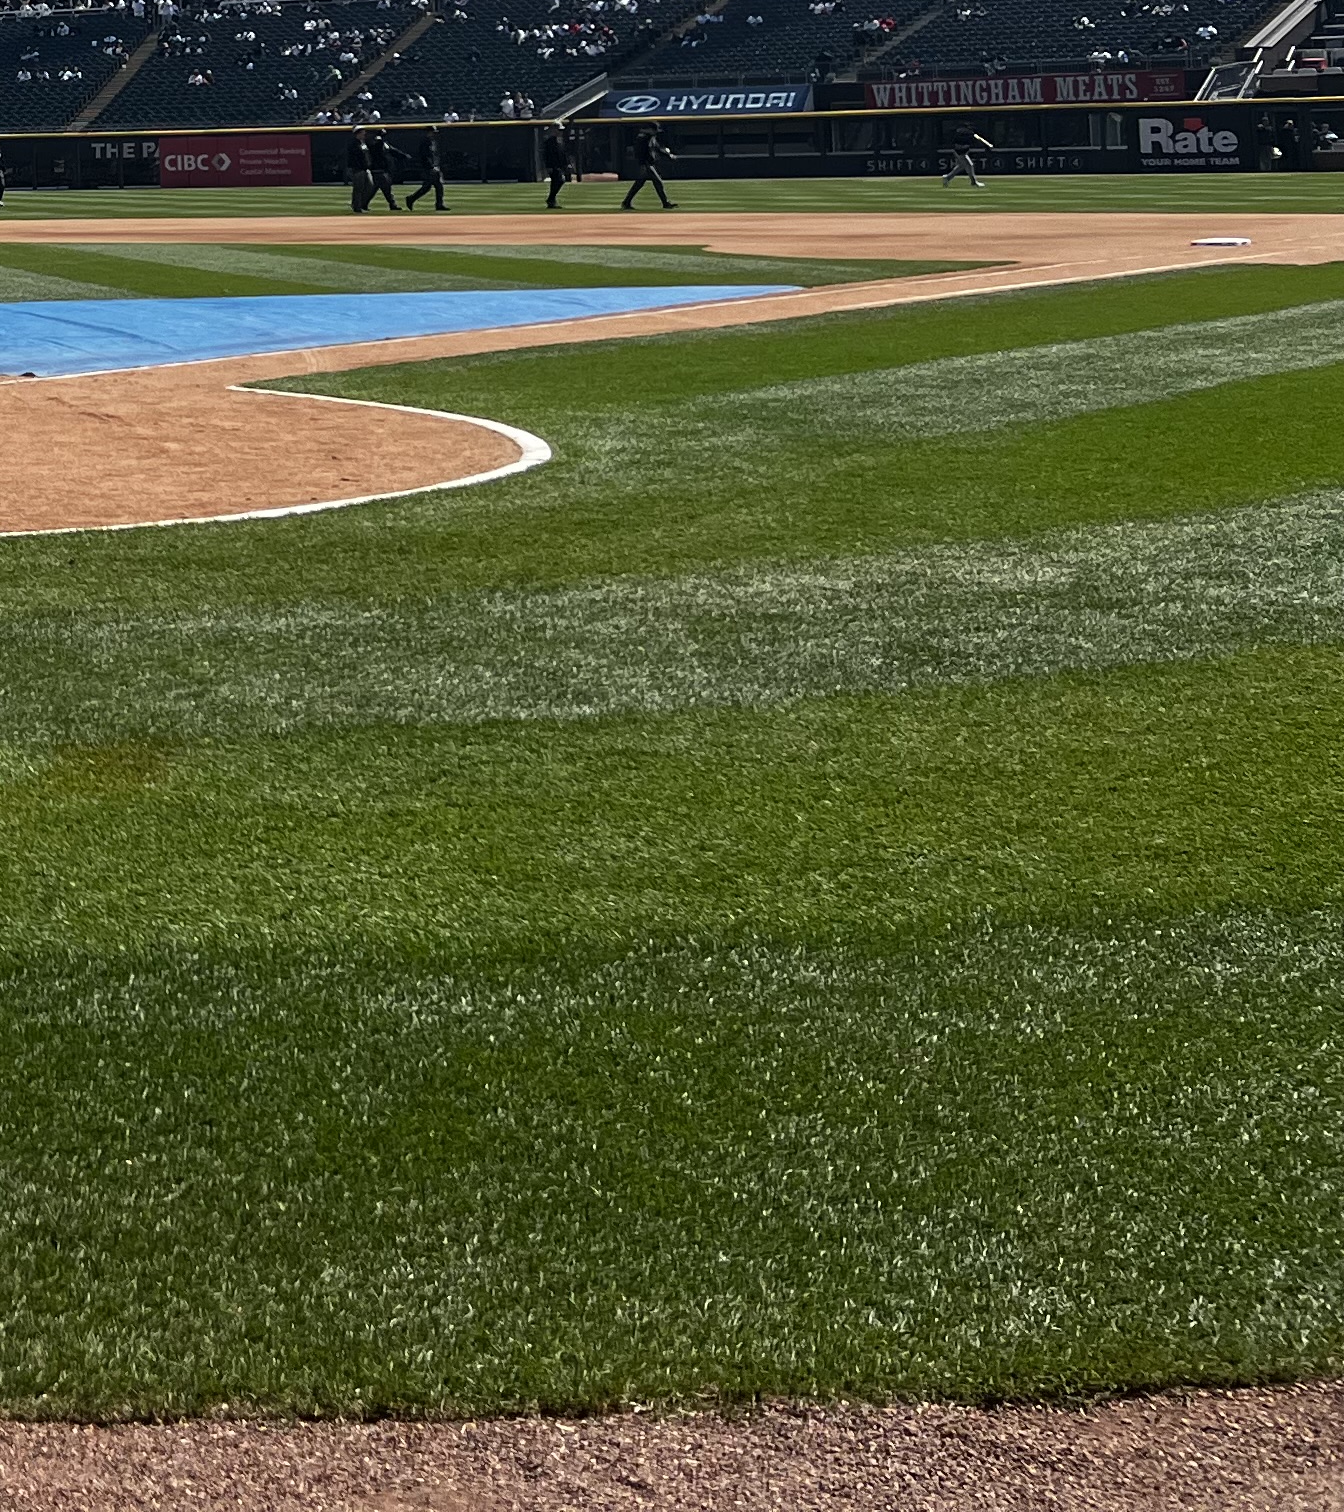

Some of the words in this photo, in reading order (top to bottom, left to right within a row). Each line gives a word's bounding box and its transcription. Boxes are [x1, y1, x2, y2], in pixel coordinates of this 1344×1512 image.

[871, 77, 1043, 108] WHITTINGHAM
[1055, 73, 1139, 102] MEATS
[666, 92, 796, 111] HYUNDAI
[1138, 118, 1238, 154] Rate
[91, 142, 135, 158] THE
[164, 154, 209, 171] CIBC
[1142, 158, 1172, 166] YOUR
[1174, 157, 1208, 166] HOME
[1210, 156, 1239, 165] TEAM
